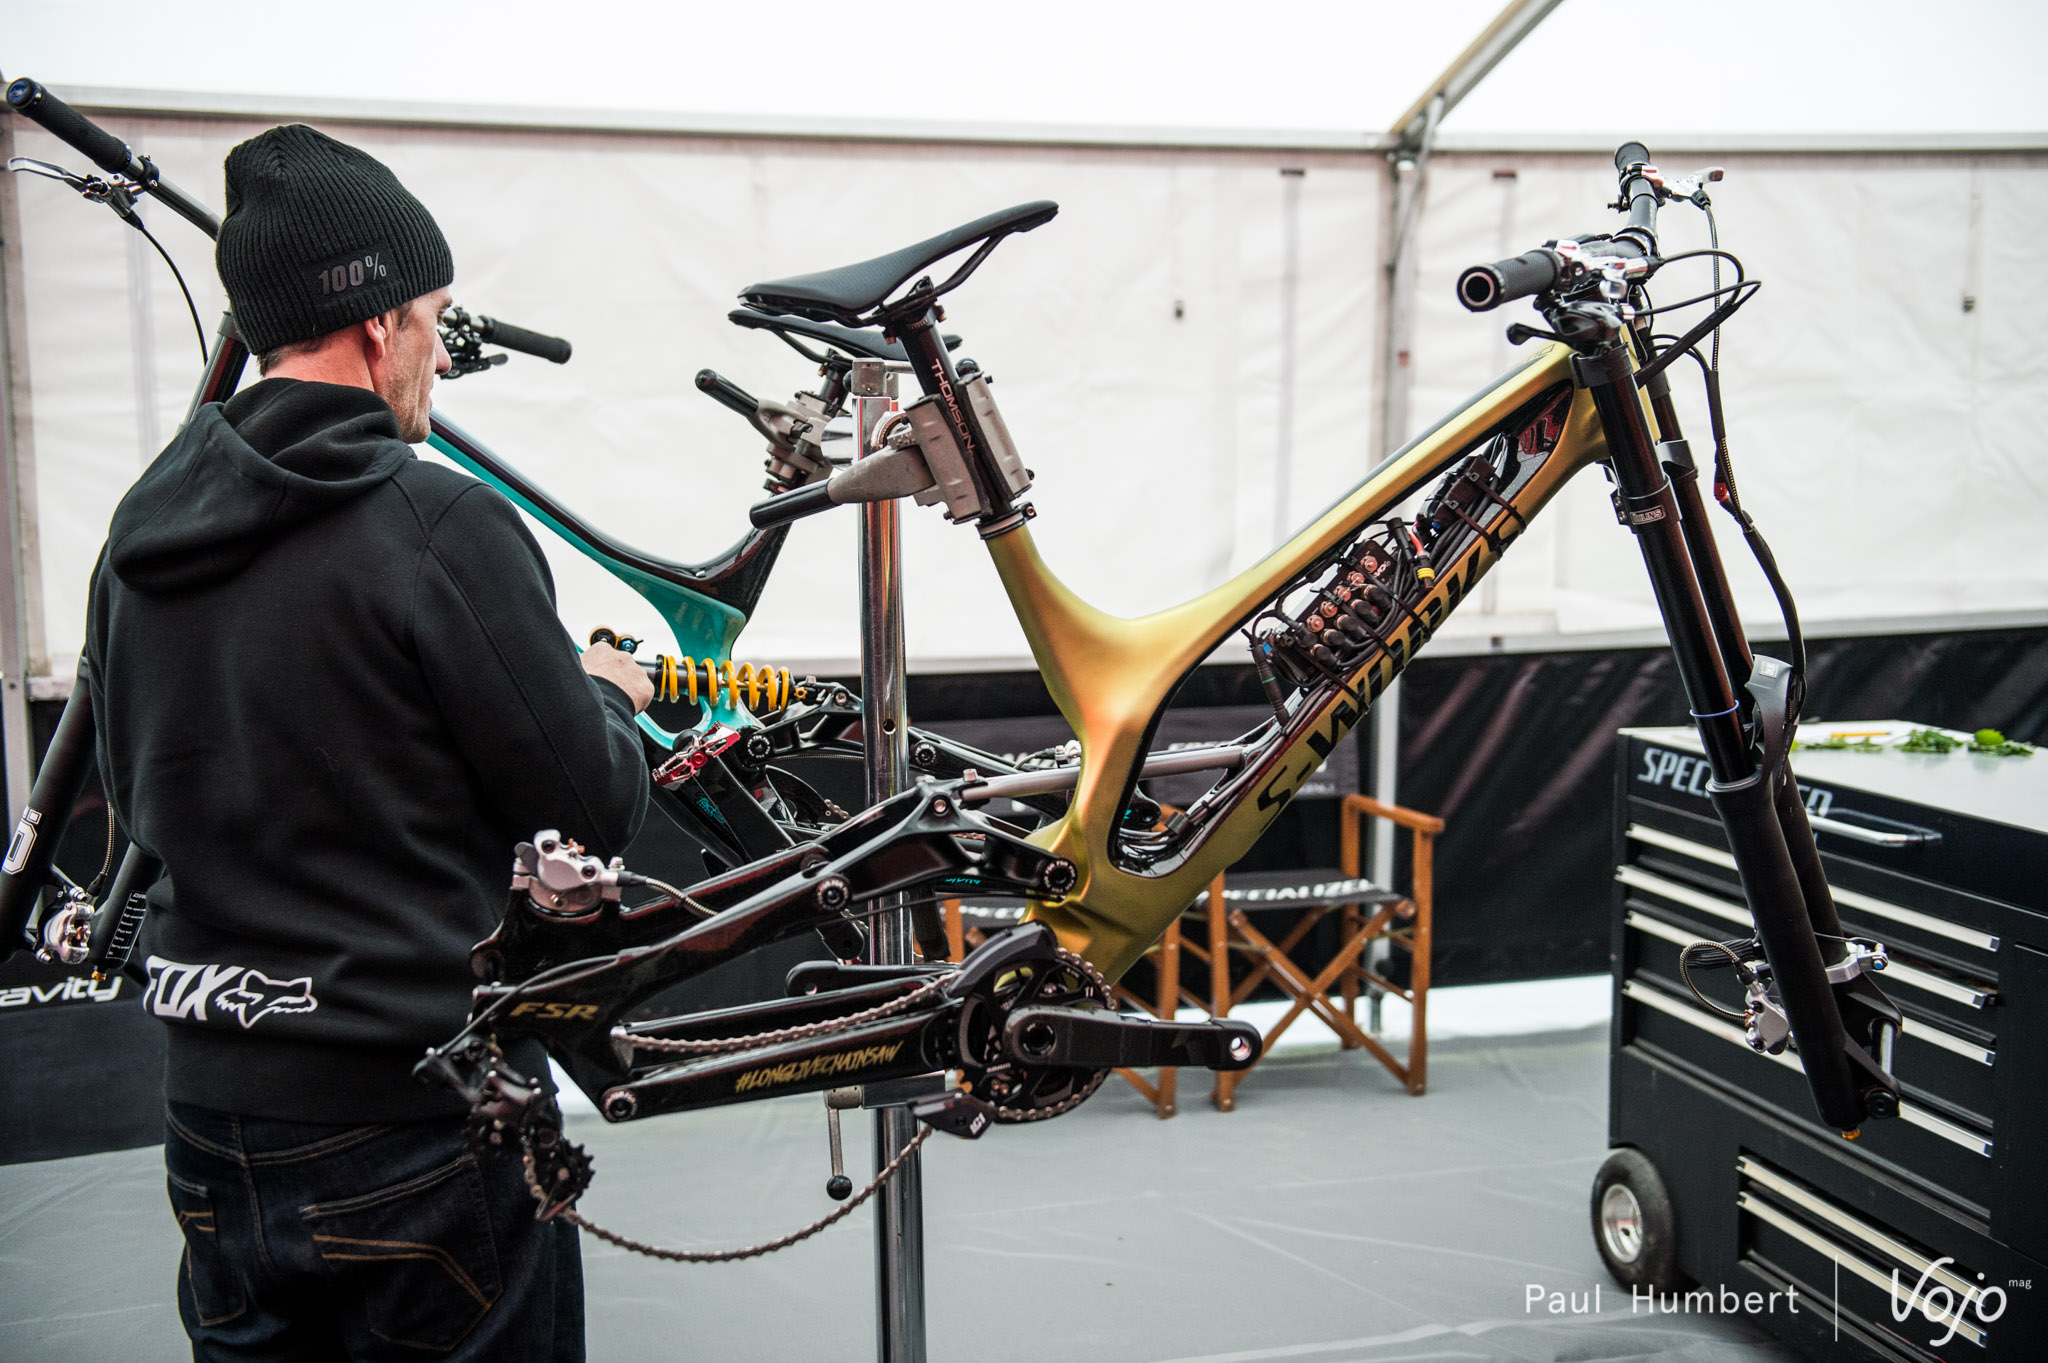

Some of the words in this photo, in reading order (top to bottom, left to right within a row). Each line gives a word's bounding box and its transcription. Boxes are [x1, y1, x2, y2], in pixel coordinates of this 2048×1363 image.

[318, 252, 387, 296] 100%
[931, 358, 975, 450] THOMSON
[143, 955, 246, 1021] FOX
[509, 1002, 599, 1019] FSR
[735, 1040, 904, 1093] #LONGLIVECHAINSAW
